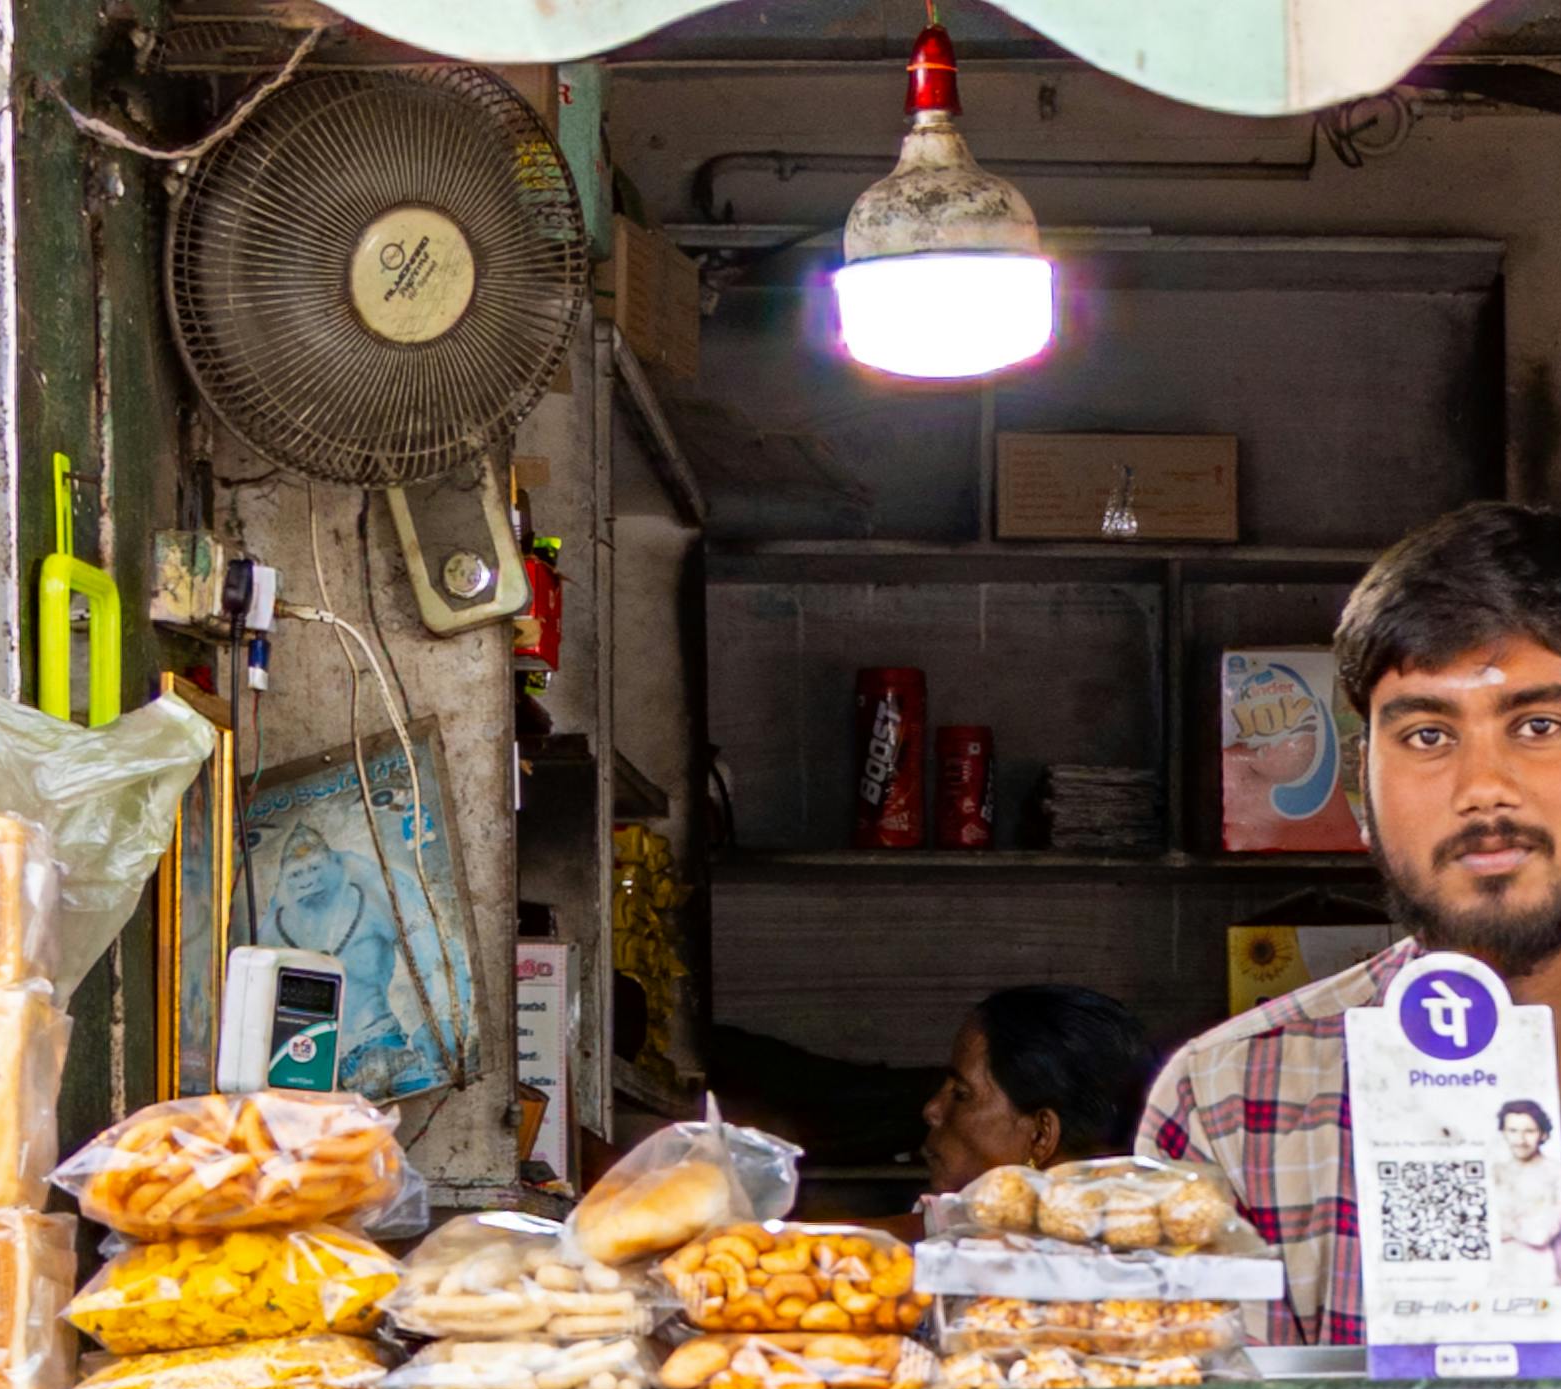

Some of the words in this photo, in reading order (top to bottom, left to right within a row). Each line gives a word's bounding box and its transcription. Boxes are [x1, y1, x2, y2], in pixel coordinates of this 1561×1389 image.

[861, 700, 901, 806] BOOST
[1422, 980, 1472, 1048] पे
[1409, 1069, 1497, 1088] PhonePe
[1393, 1300, 1469, 1316] BHIM
